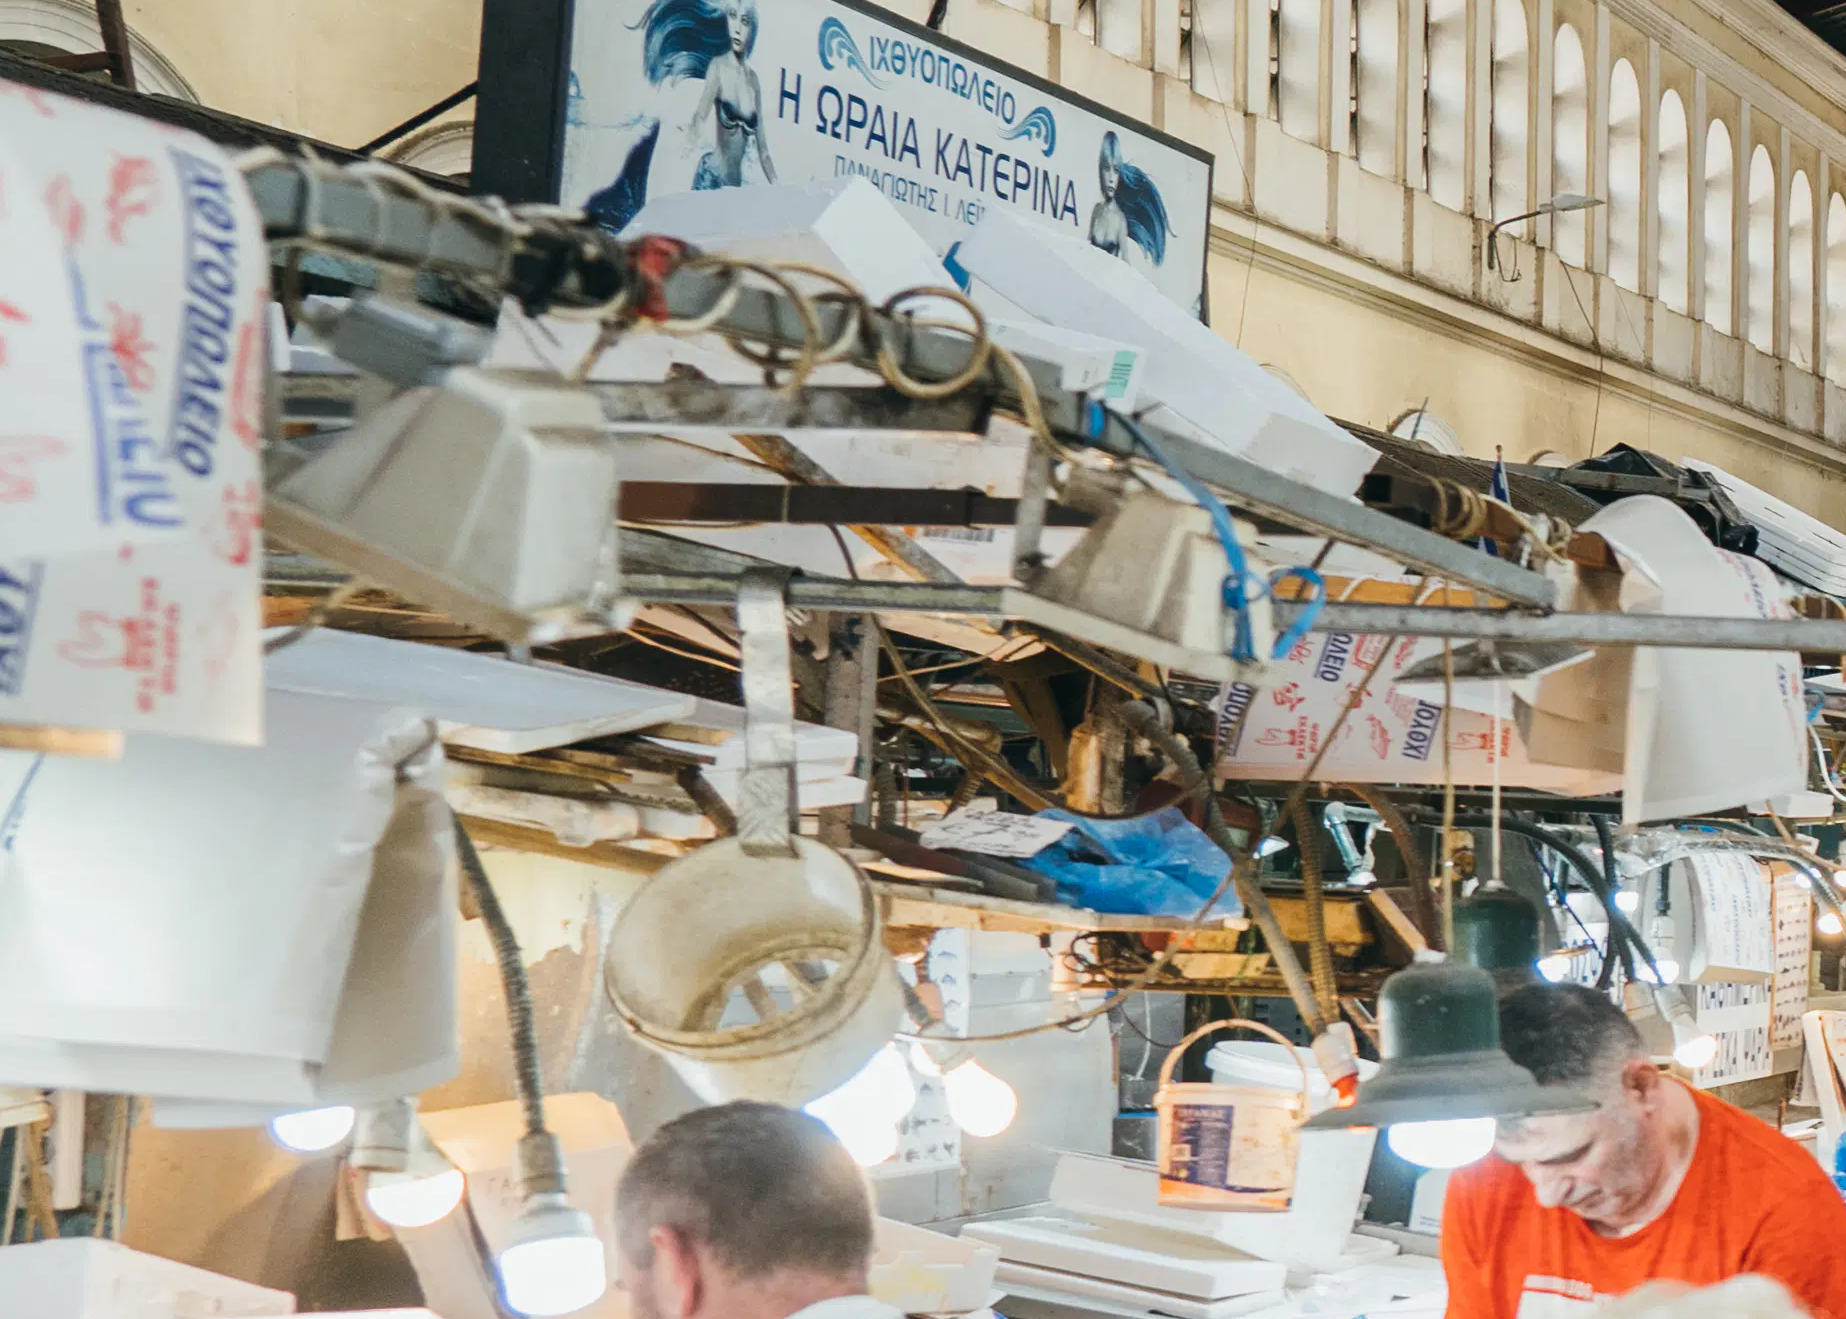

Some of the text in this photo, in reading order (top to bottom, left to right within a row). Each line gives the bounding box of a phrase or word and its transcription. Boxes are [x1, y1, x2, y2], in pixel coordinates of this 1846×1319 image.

[869, 35, 1016, 125] ΙΧΘΥΟΠΩΛΕΙΟ
[778, 67, 1079, 227] Η ΩΡΑΙΑ ΚΑΤΕΡΙΝΑ
